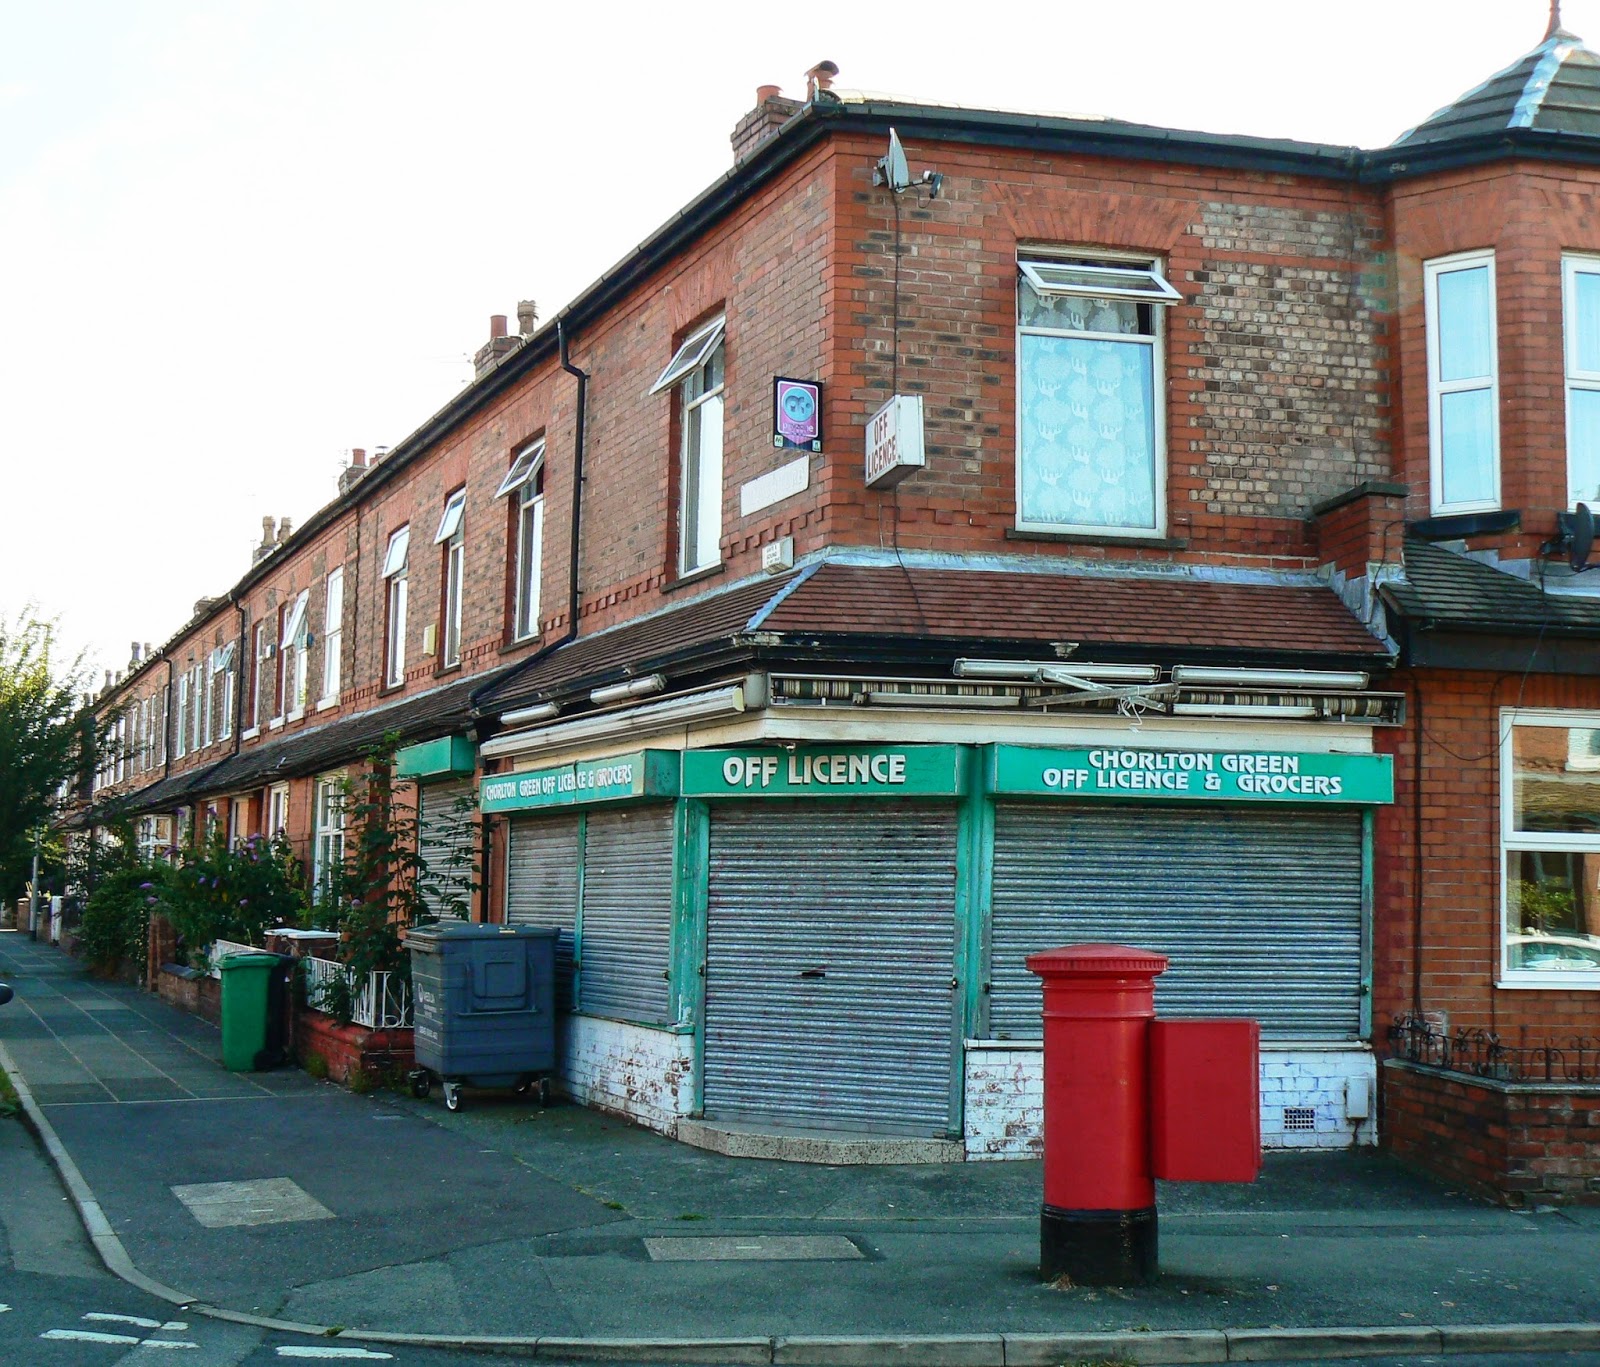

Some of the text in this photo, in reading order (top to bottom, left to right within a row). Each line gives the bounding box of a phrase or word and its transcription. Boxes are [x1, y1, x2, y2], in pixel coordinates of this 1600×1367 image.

[873, 411, 888, 446] OFF
[867, 434, 897, 480] LICENCE
[723, 754, 906, 787] OFF LICENCE
[1088, 750, 1299, 774] CHORLTON GREEN
[486, 764, 633, 801] CHORLTON GREEN OFF LICENCE & GROCERS
[1042, 768, 1342, 796] OFF LICENCE & GROCERS
